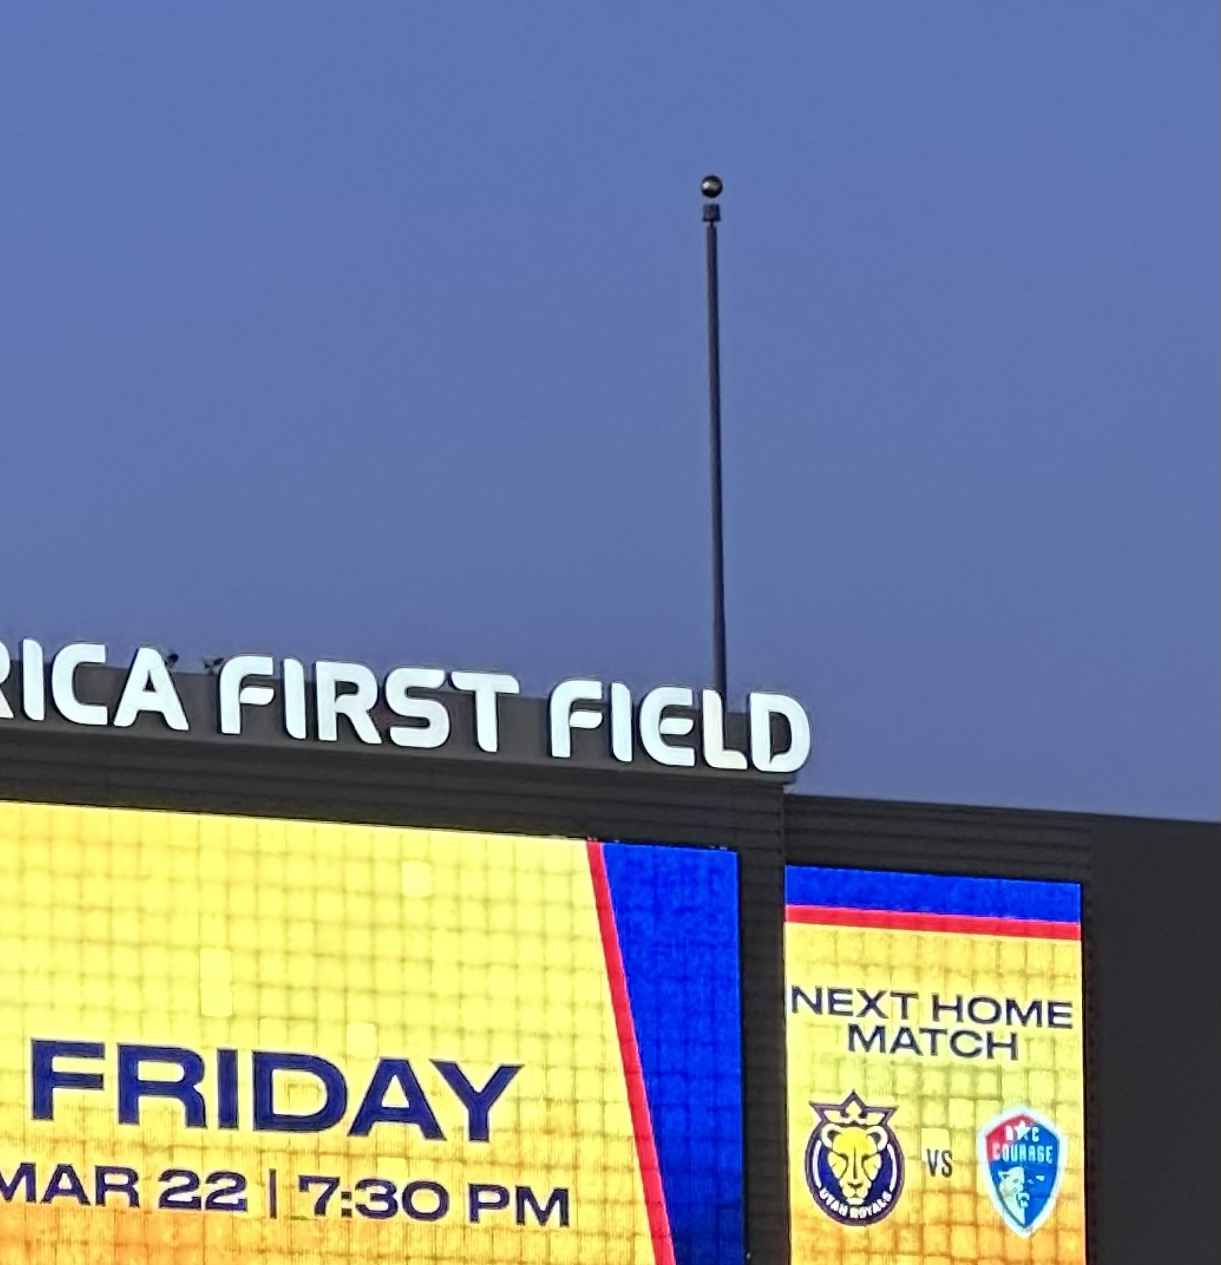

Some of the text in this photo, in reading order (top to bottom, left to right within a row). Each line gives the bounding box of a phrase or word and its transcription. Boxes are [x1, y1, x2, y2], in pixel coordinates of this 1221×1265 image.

[218, 655, 519, 753] FIRST
[548, 679, 812, 774] FIELD
[790, 985, 1074, 1029] NEXT HOME
[847, 1024, 1018, 1060] MATCH
[30, 1037, 525, 1144] FRIDAY
[926, 1148, 954, 1179] VS
[157, 1168, 248, 1213] 22
[298, 1176, 450, 1222] 7:30
[468, 1183, 570, 1227] PM
